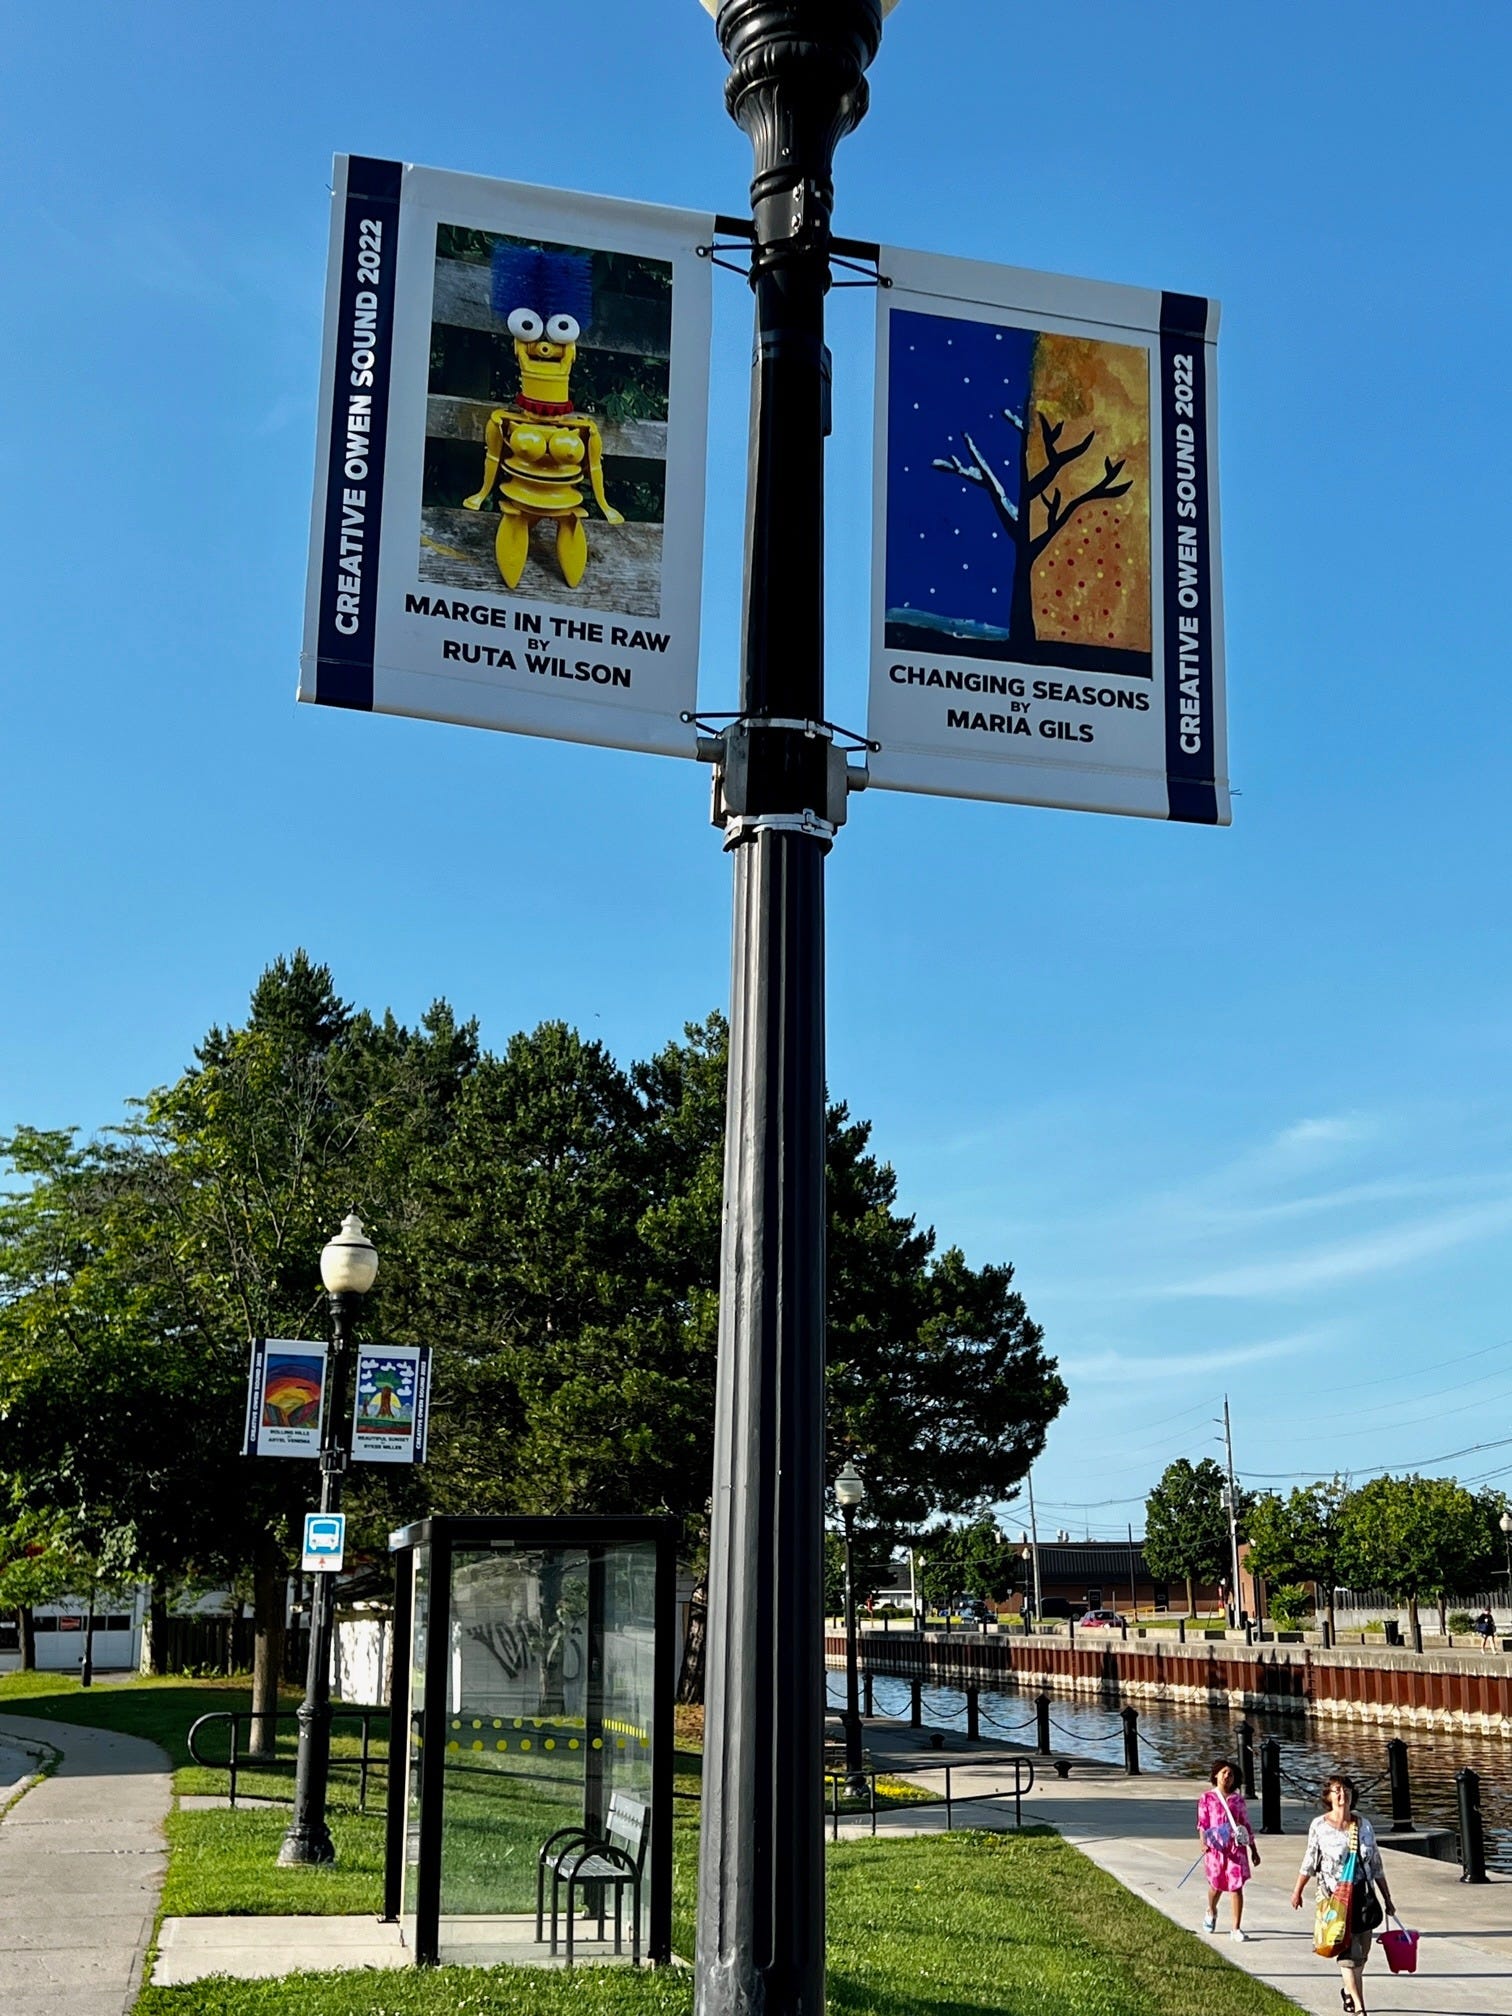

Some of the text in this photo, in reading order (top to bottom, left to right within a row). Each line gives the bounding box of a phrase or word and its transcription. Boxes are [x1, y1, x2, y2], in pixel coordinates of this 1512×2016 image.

[335, 218, 382, 635] CREATIVE OWEN SOUND 2022
[1173, 354, 1201, 754] CREATIVE OWEN SOUND 2022
[405, 593, 671, 653] MARGE IN THE RAW
[527, 638, 551, 652] BY
[442, 640, 632, 688] RUTA WILSON
[889, 664, 1151, 711] CHANGING SEASONS
[1010, 701, 1031, 714] BY
[947, 709, 1094, 743] MARIA GILS
[252, 1391, 260, 1410] OWEN
[418, 1376, 426, 1398] SOUND
[250, 1411, 258, 1442] CREATIVE
[415, 1419, 423, 1450] CREATIVE
